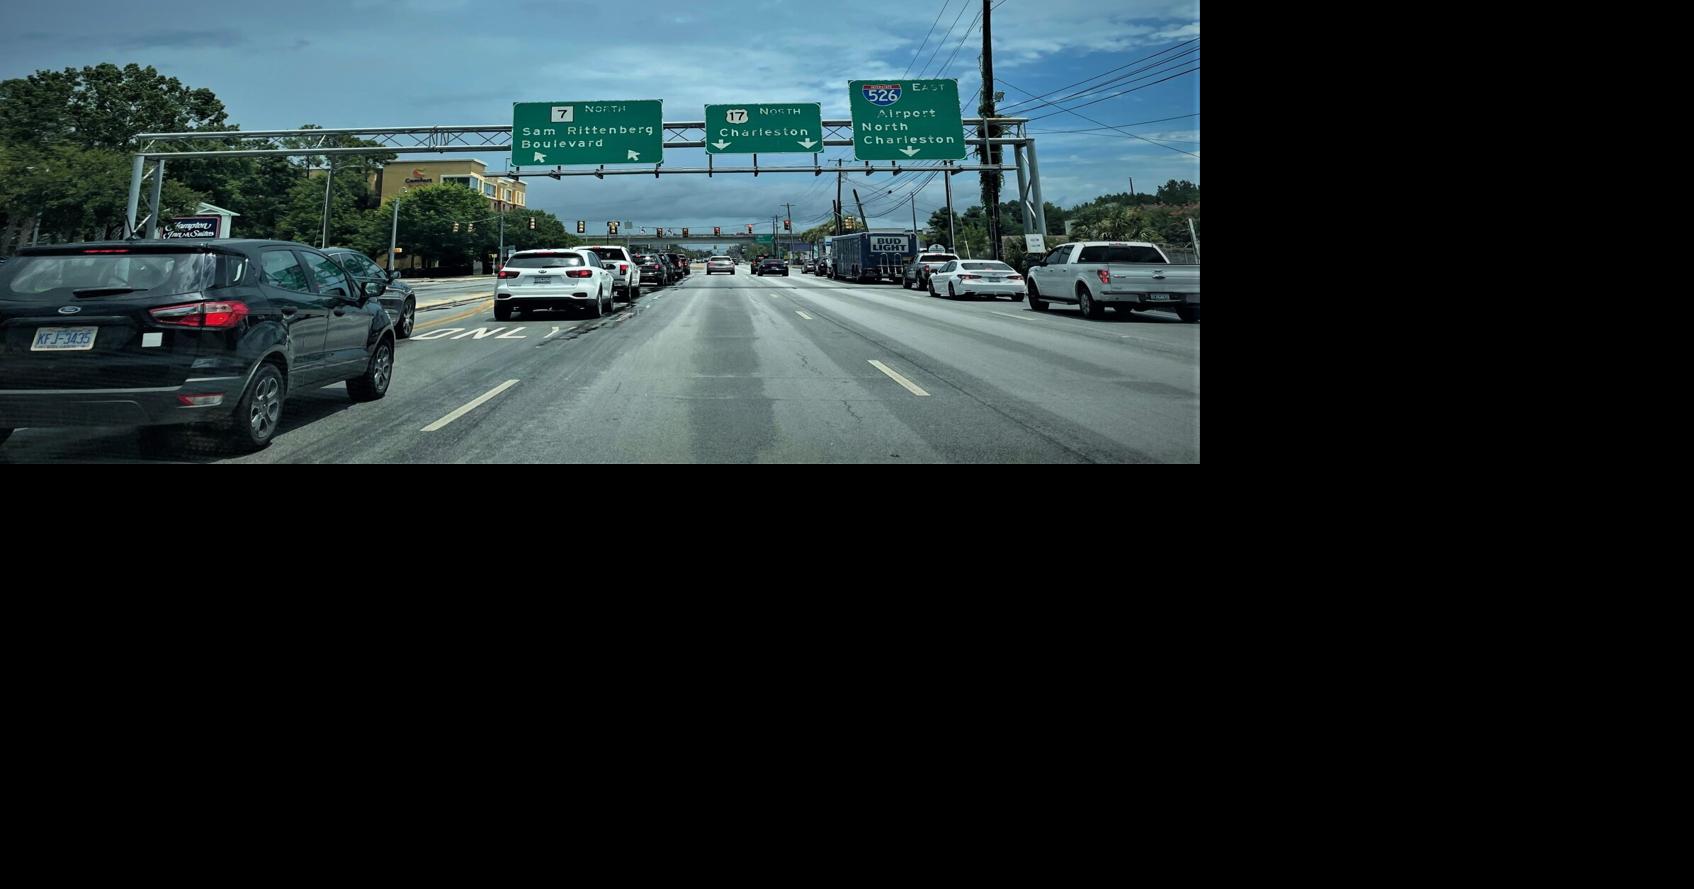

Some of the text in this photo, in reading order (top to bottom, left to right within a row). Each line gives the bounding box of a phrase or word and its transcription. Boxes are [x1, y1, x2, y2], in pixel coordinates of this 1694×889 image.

[868, 83, 945, 102] 526 EAST
[557, 105, 626, 119] 7 NORTH
[729, 107, 801, 121] 17 NORTH
[877, 109, 936, 119] Airport
[522, 125, 653, 136] Sam Rittenberg
[862, 122, 908, 131] North
[719, 128, 808, 137] Charleston
[521, 139, 603, 149] Boulevard
[863, 135, 955, 145] Charleston
